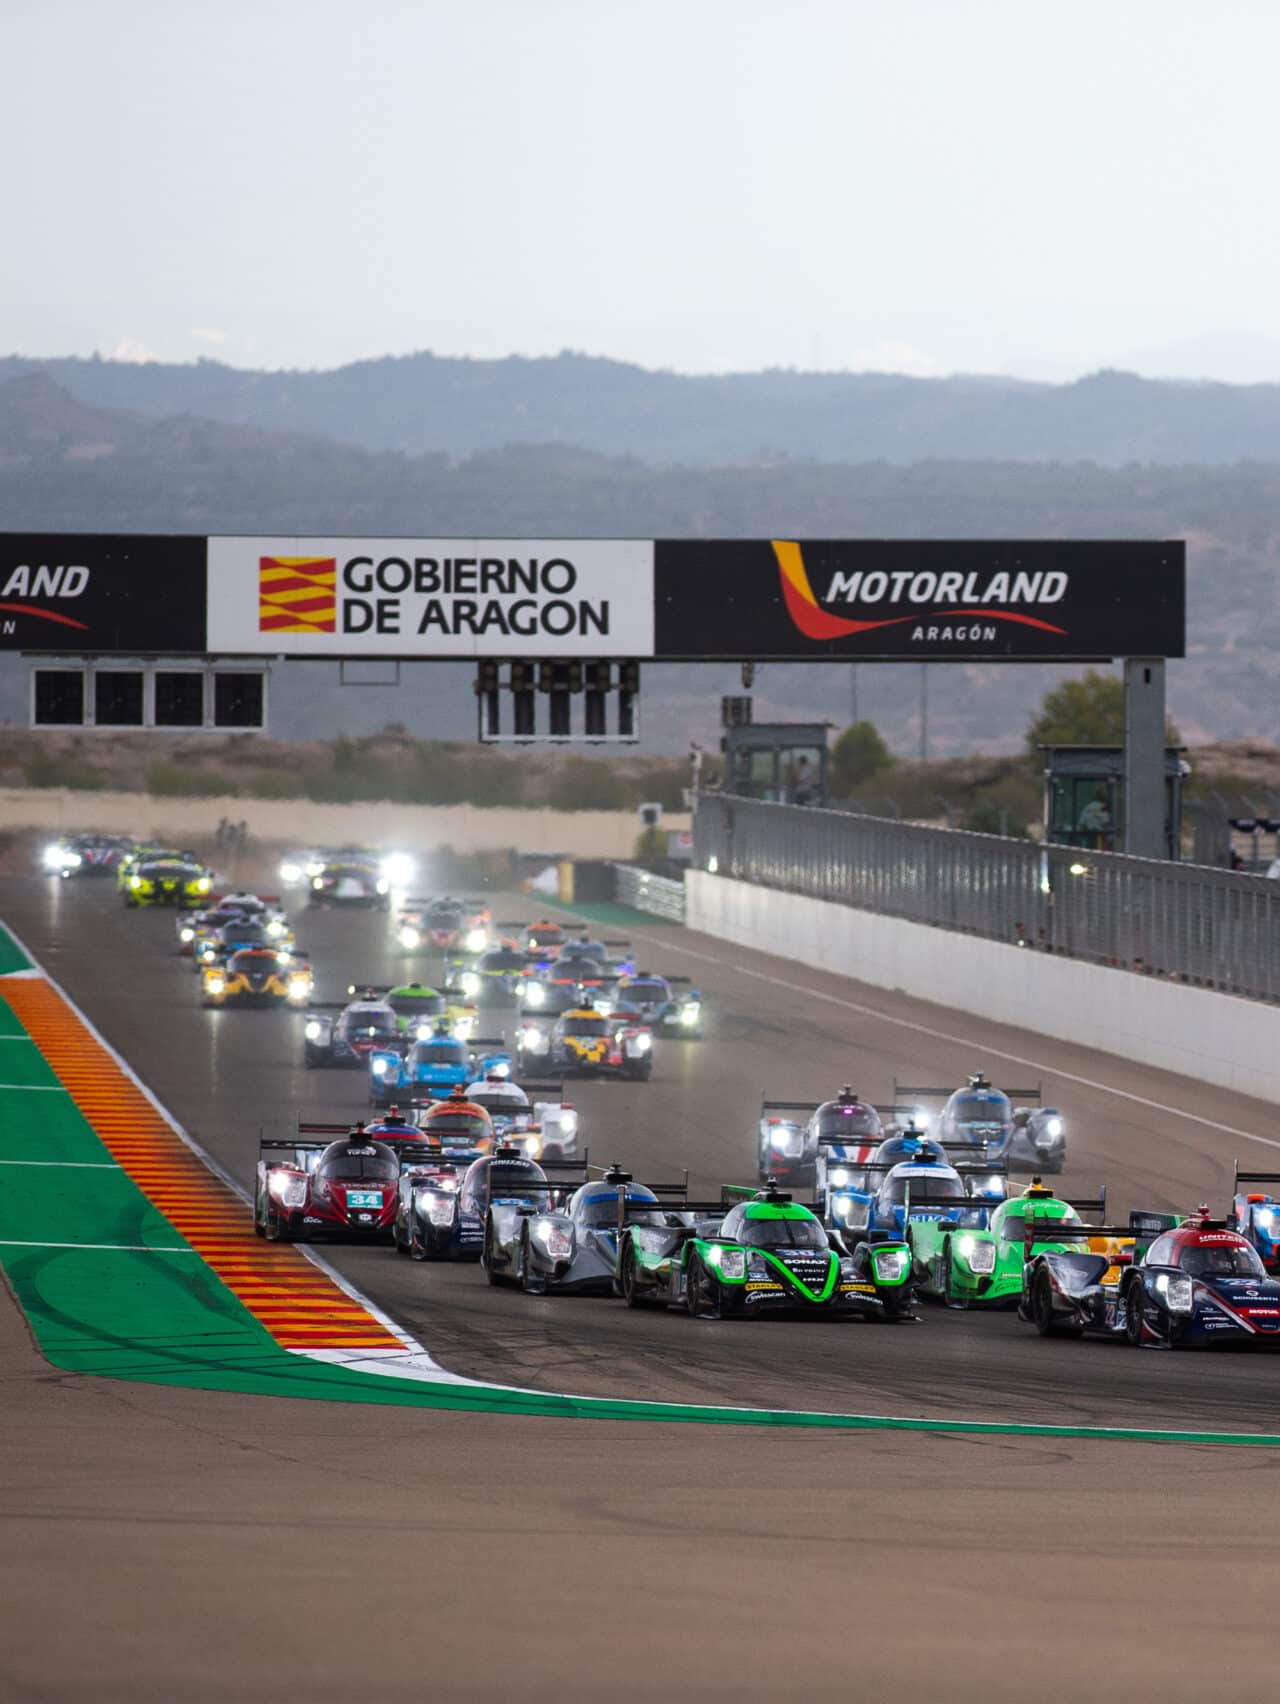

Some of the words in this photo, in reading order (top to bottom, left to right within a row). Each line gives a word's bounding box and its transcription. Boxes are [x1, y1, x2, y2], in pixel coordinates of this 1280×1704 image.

[342, 556, 578, 594] GOBIERNO
[826, 571, 1069, 604] MOTORLAND
[343, 602, 400, 634] DE
[417, 600, 610, 636] ARAGON
[911, 623, 996, 641] ARAGÓN
[351, 1194, 379, 1206] 34
[1105, 1304, 1115, 1326] 22
